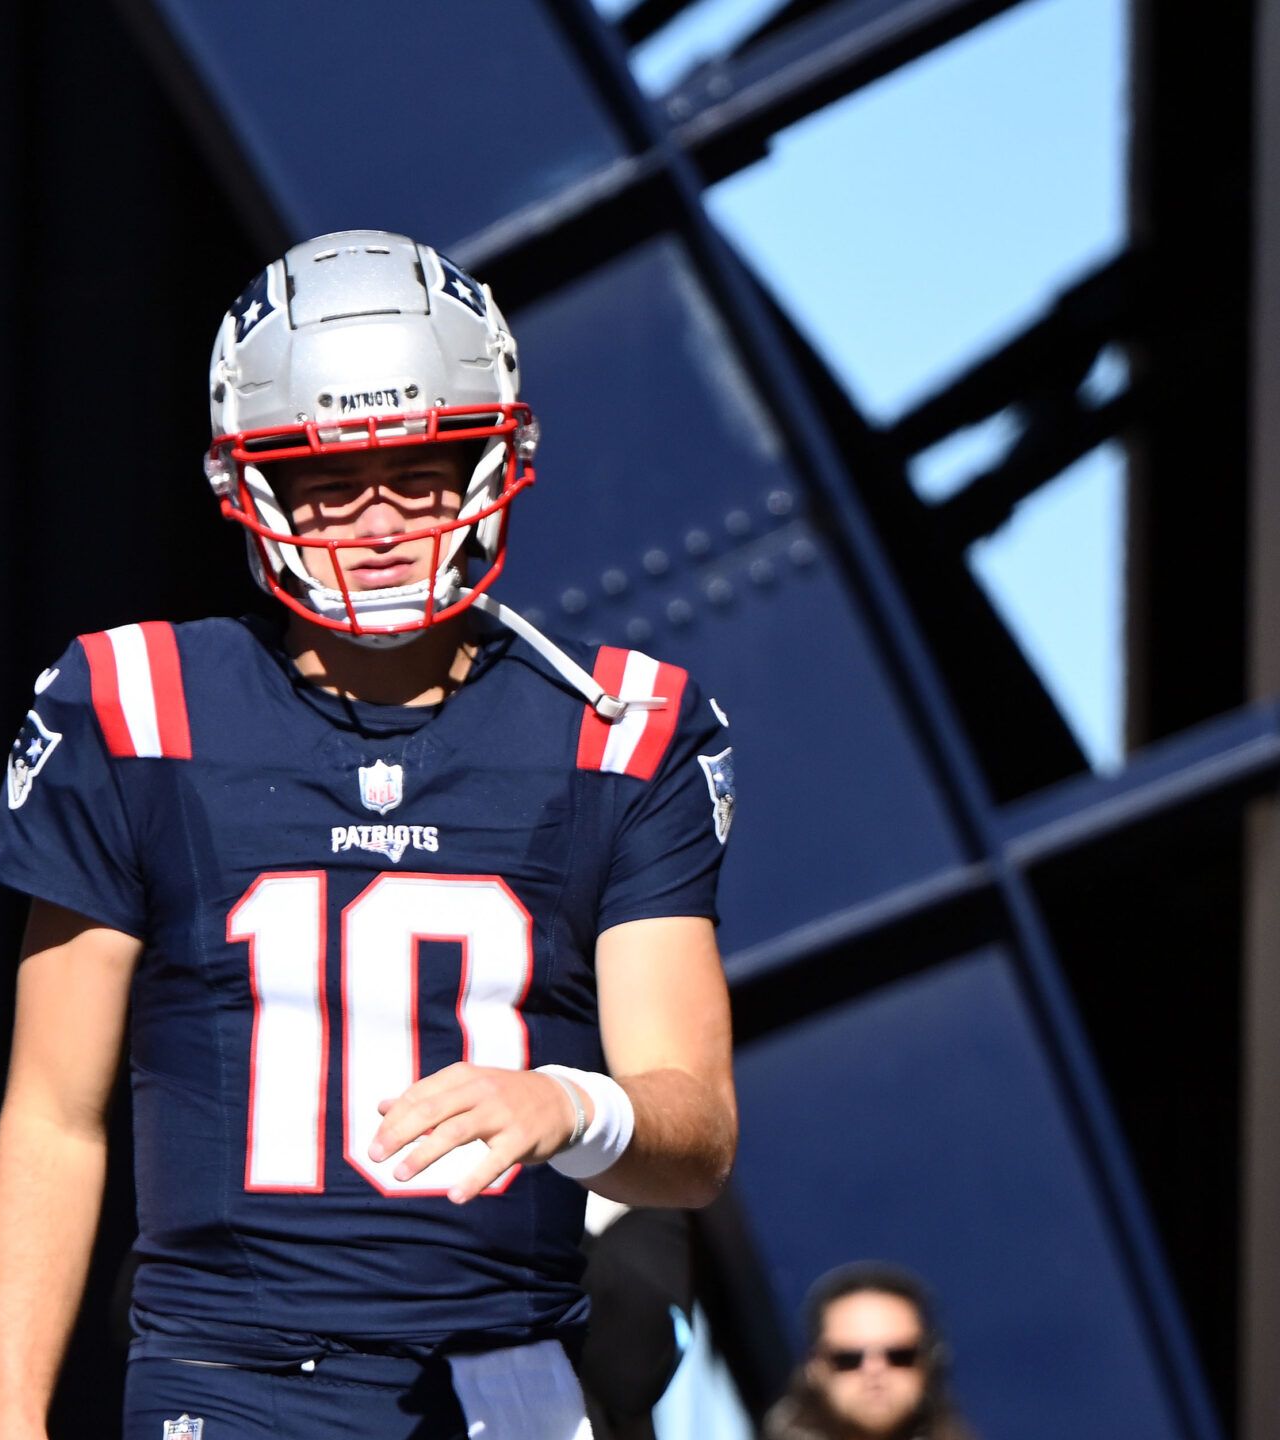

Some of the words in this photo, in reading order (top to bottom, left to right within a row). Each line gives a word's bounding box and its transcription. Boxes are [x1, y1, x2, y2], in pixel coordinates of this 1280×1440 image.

[340, 388, 399, 414] PATRIOTS
[331, 825, 439, 853] PATRIOTS
[226, 869, 534, 1199] 10
